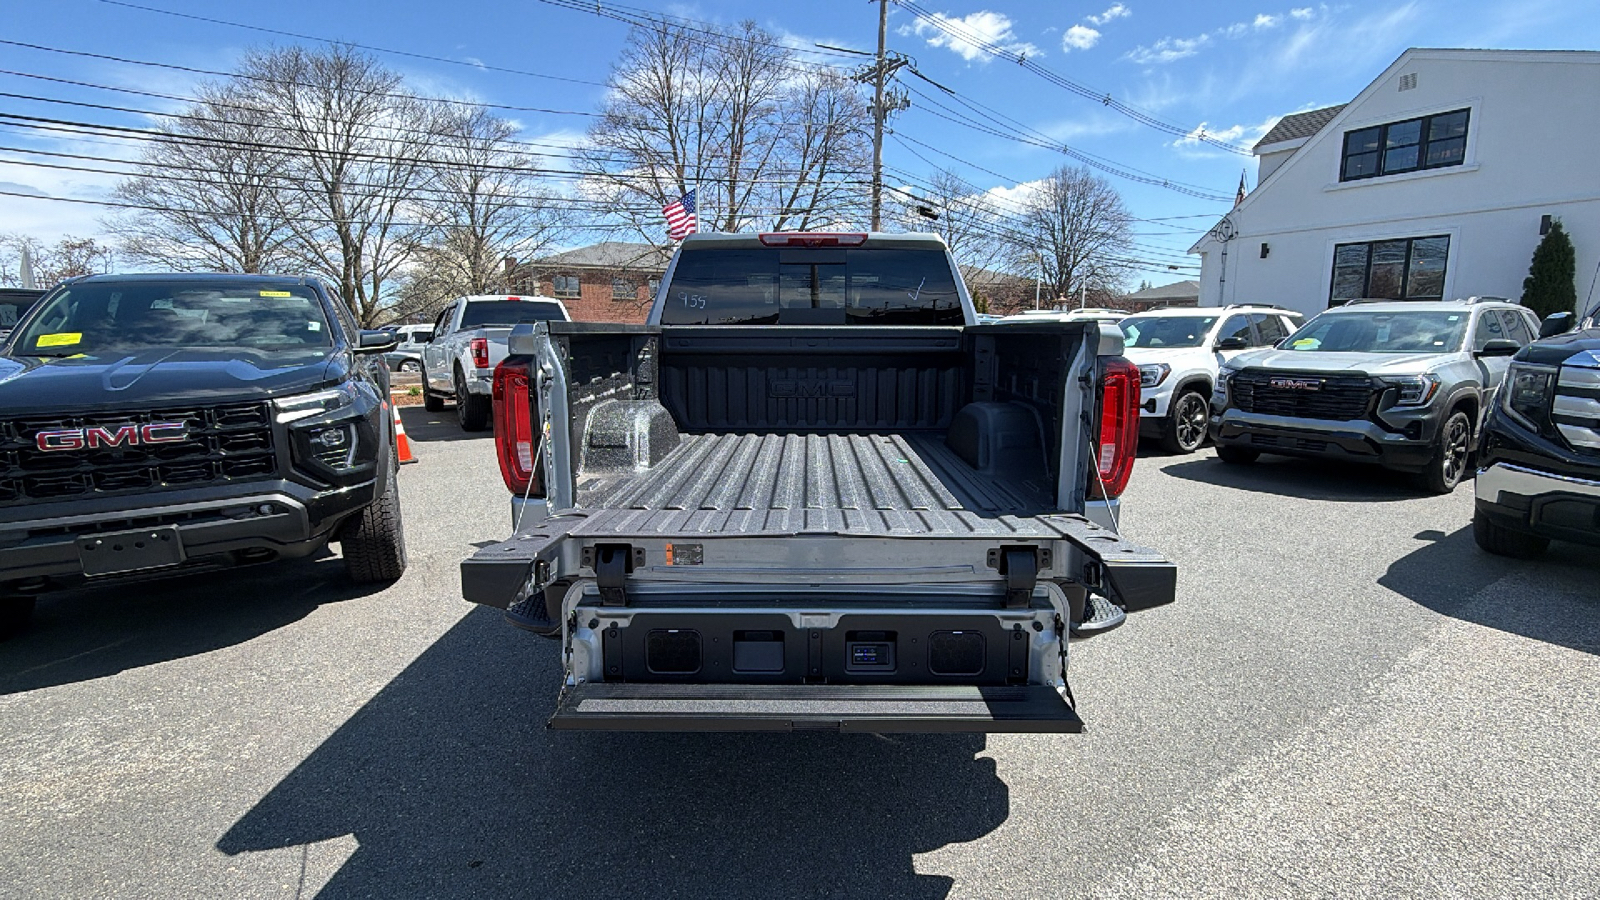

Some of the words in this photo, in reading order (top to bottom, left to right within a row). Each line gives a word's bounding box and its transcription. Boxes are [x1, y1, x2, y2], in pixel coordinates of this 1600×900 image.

[771, 379, 854, 398] GMC
[1270, 379, 1320, 390] GMC
[35, 420, 188, 452] GMC
